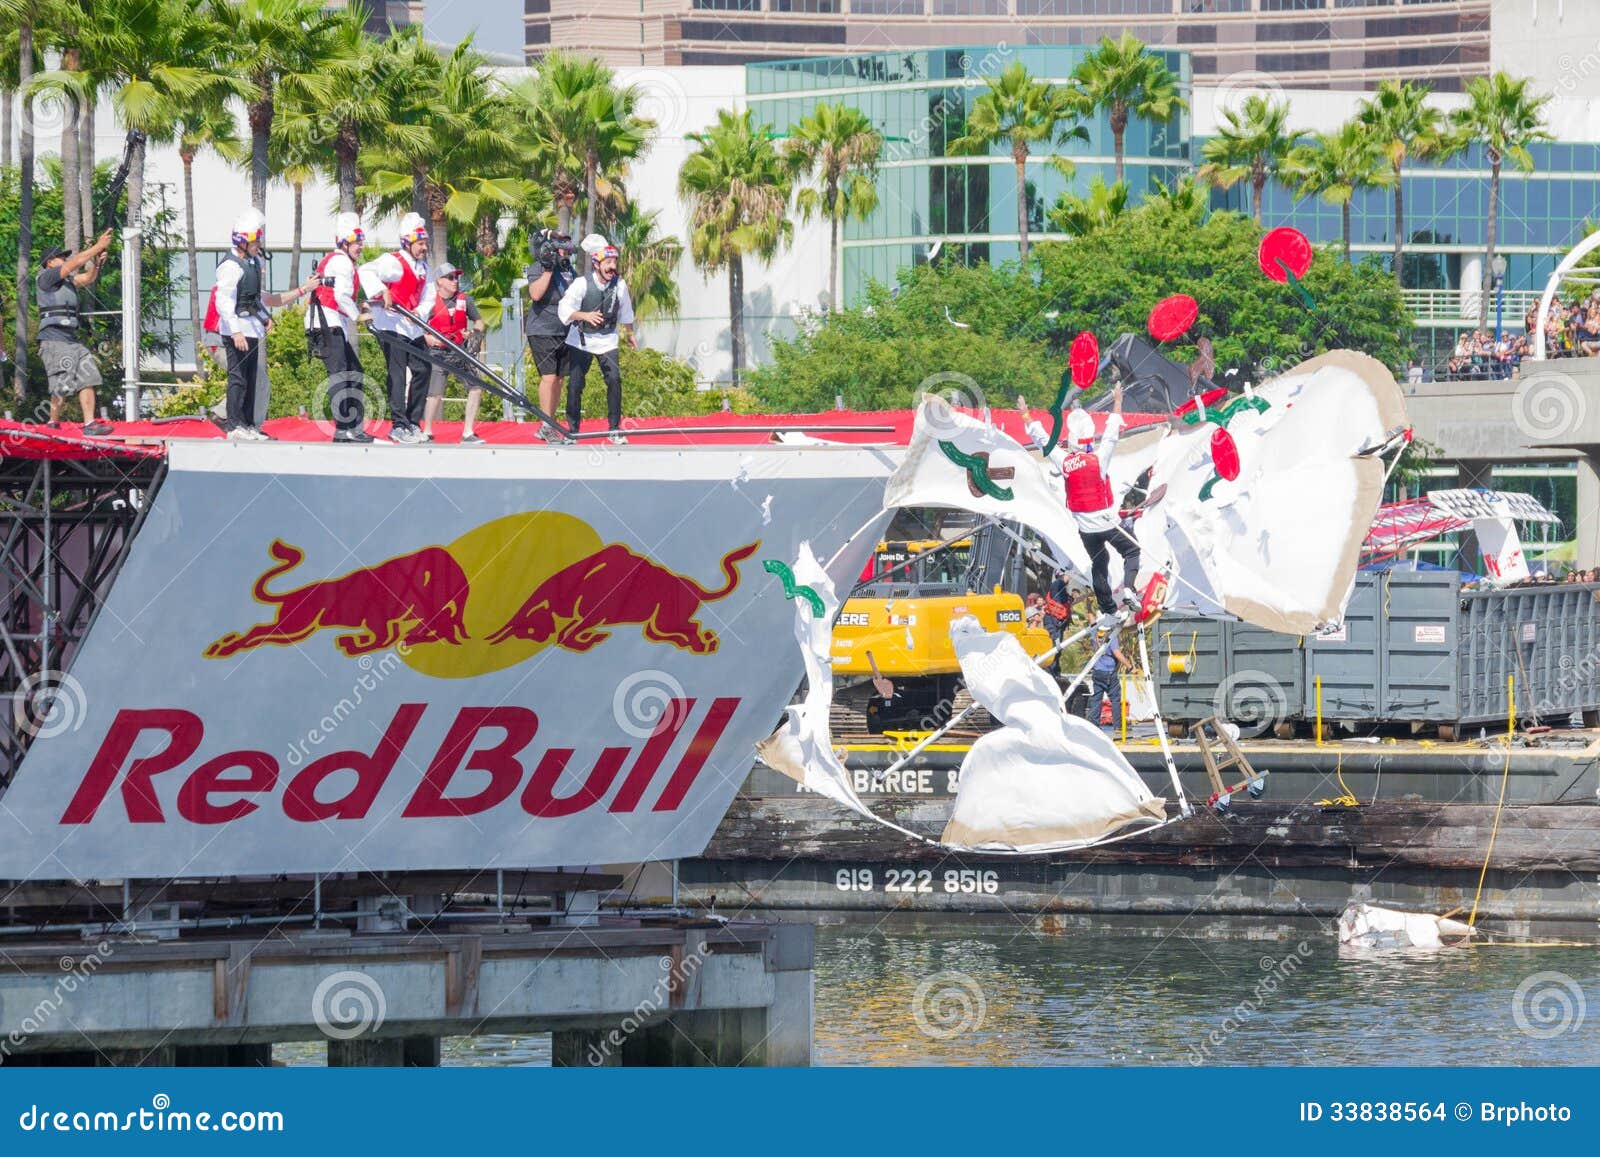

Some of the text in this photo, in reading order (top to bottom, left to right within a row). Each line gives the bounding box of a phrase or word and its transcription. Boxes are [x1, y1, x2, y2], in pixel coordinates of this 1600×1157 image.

[59, 697, 741, 824] Red Bull
[854, 769, 934, 793] BARGE
[836, 868, 999, 893] 619 222 8516
